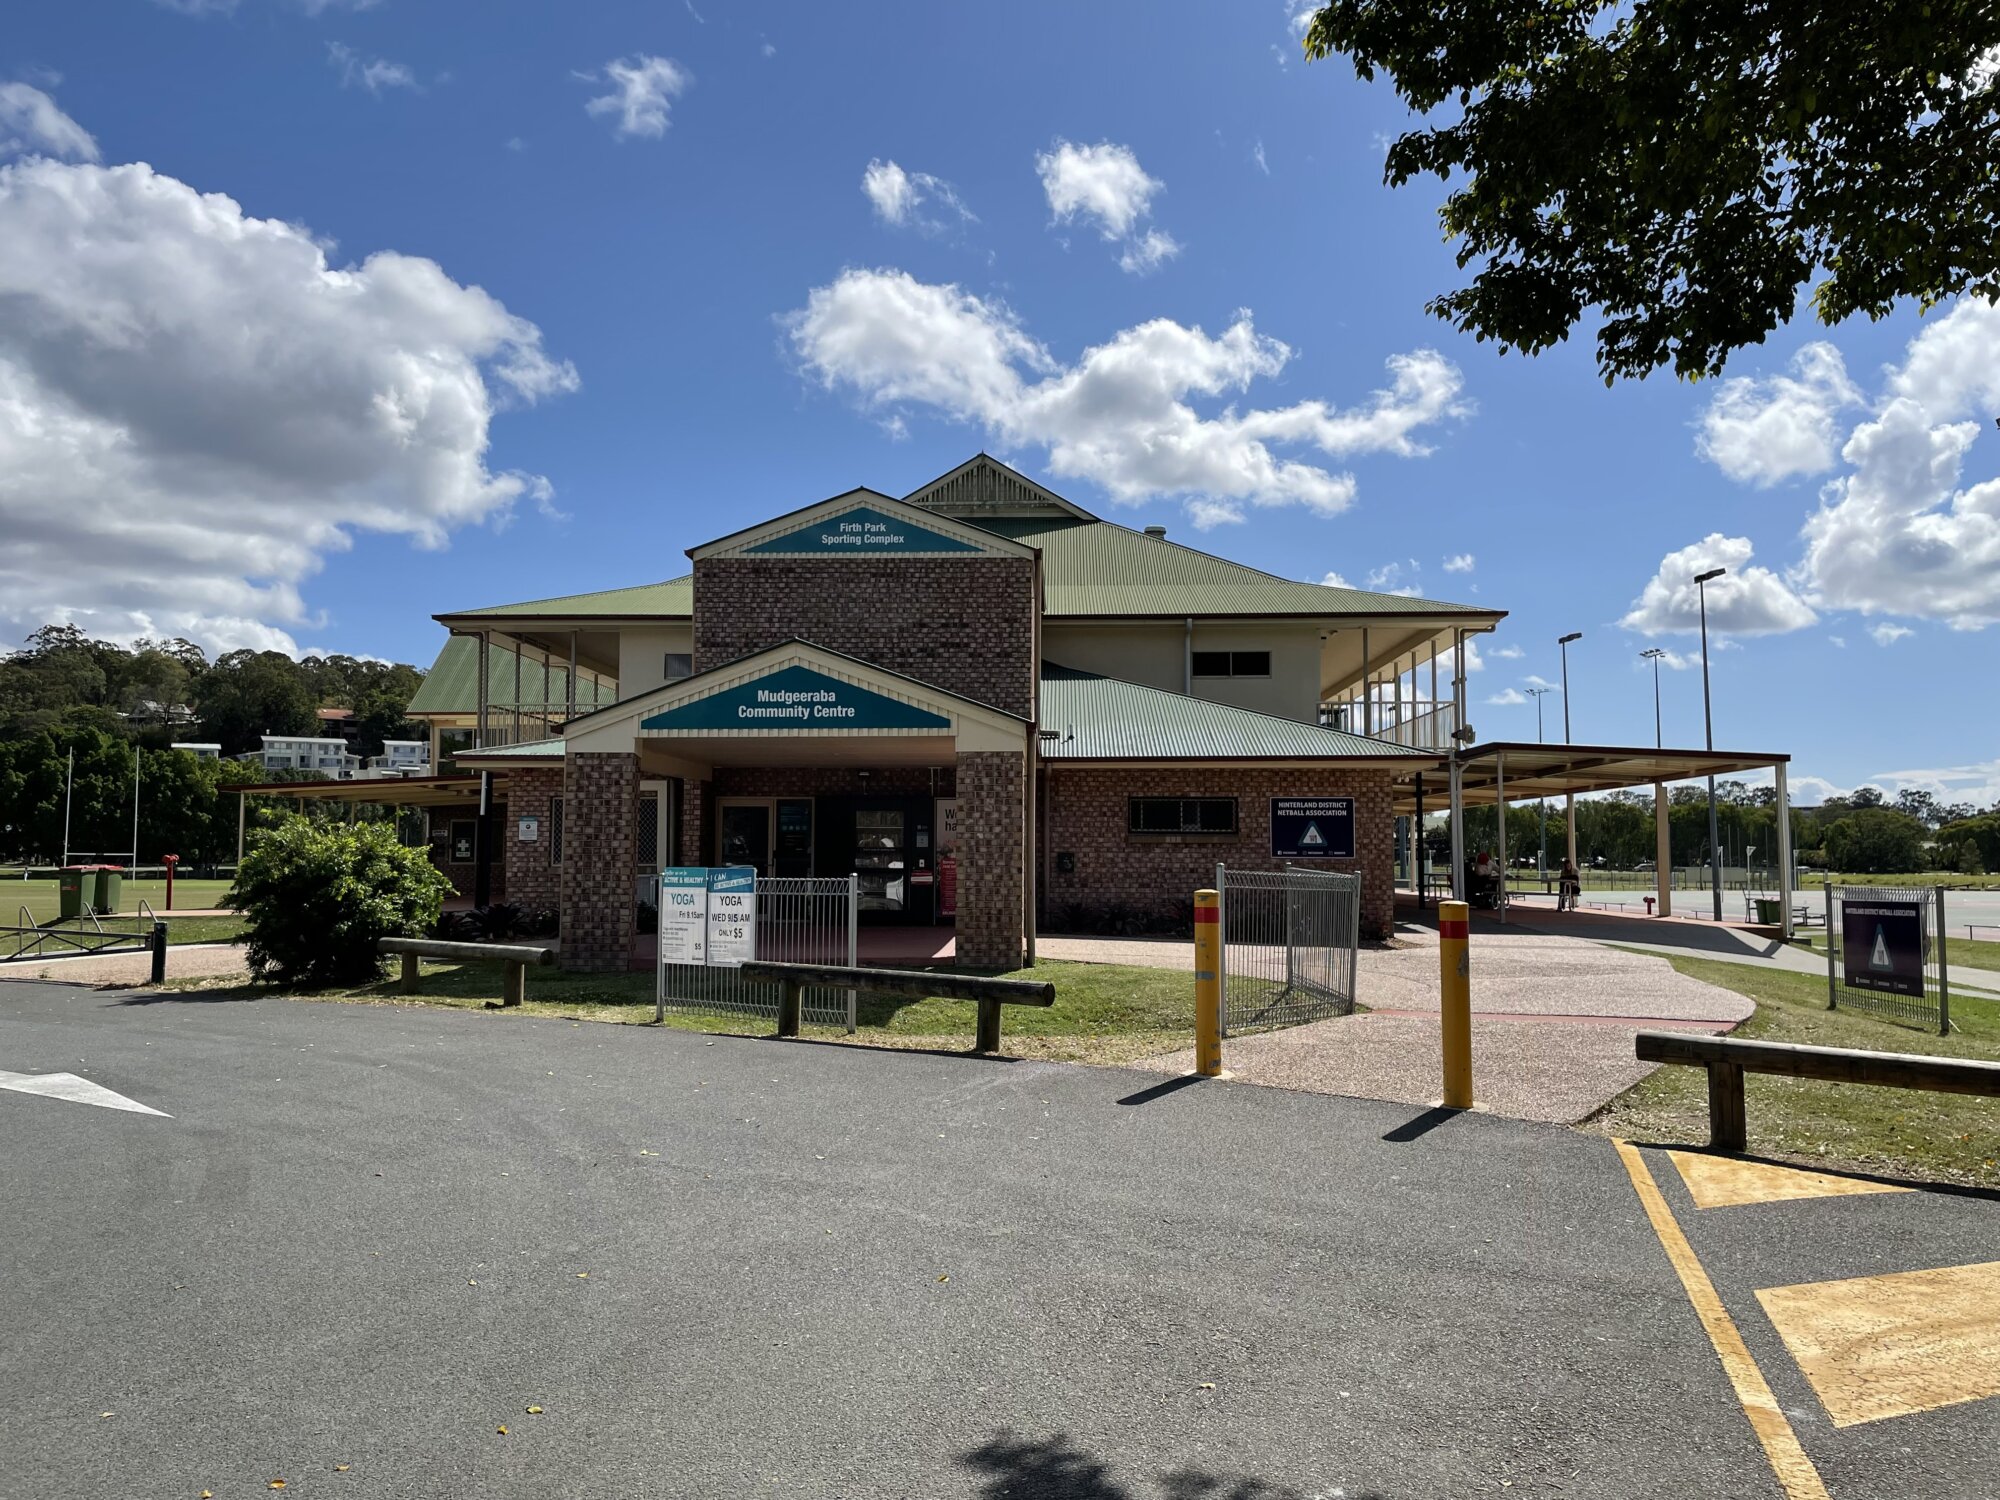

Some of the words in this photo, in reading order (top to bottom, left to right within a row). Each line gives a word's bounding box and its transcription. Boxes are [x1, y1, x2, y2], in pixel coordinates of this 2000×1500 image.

[840, 523, 862, 533] Firth
[864, 523, 886, 533] Park
[821, 534, 861, 545] Sporting
[864, 534, 905, 545] Complex
[757, 689, 836, 704] Mudgeeraba
[738, 705, 811, 720] Community
[814, 705, 855, 718] Centre
[714, 872, 727, 882] CAN
[671, 893, 695, 906] YOGA
[720, 896, 742, 906] YOGA
[711, 913, 726, 922] WED
[740, 913, 750, 922] AM
[718, 929, 732, 937] ONLY
[733, 927, 743, 939] $5
